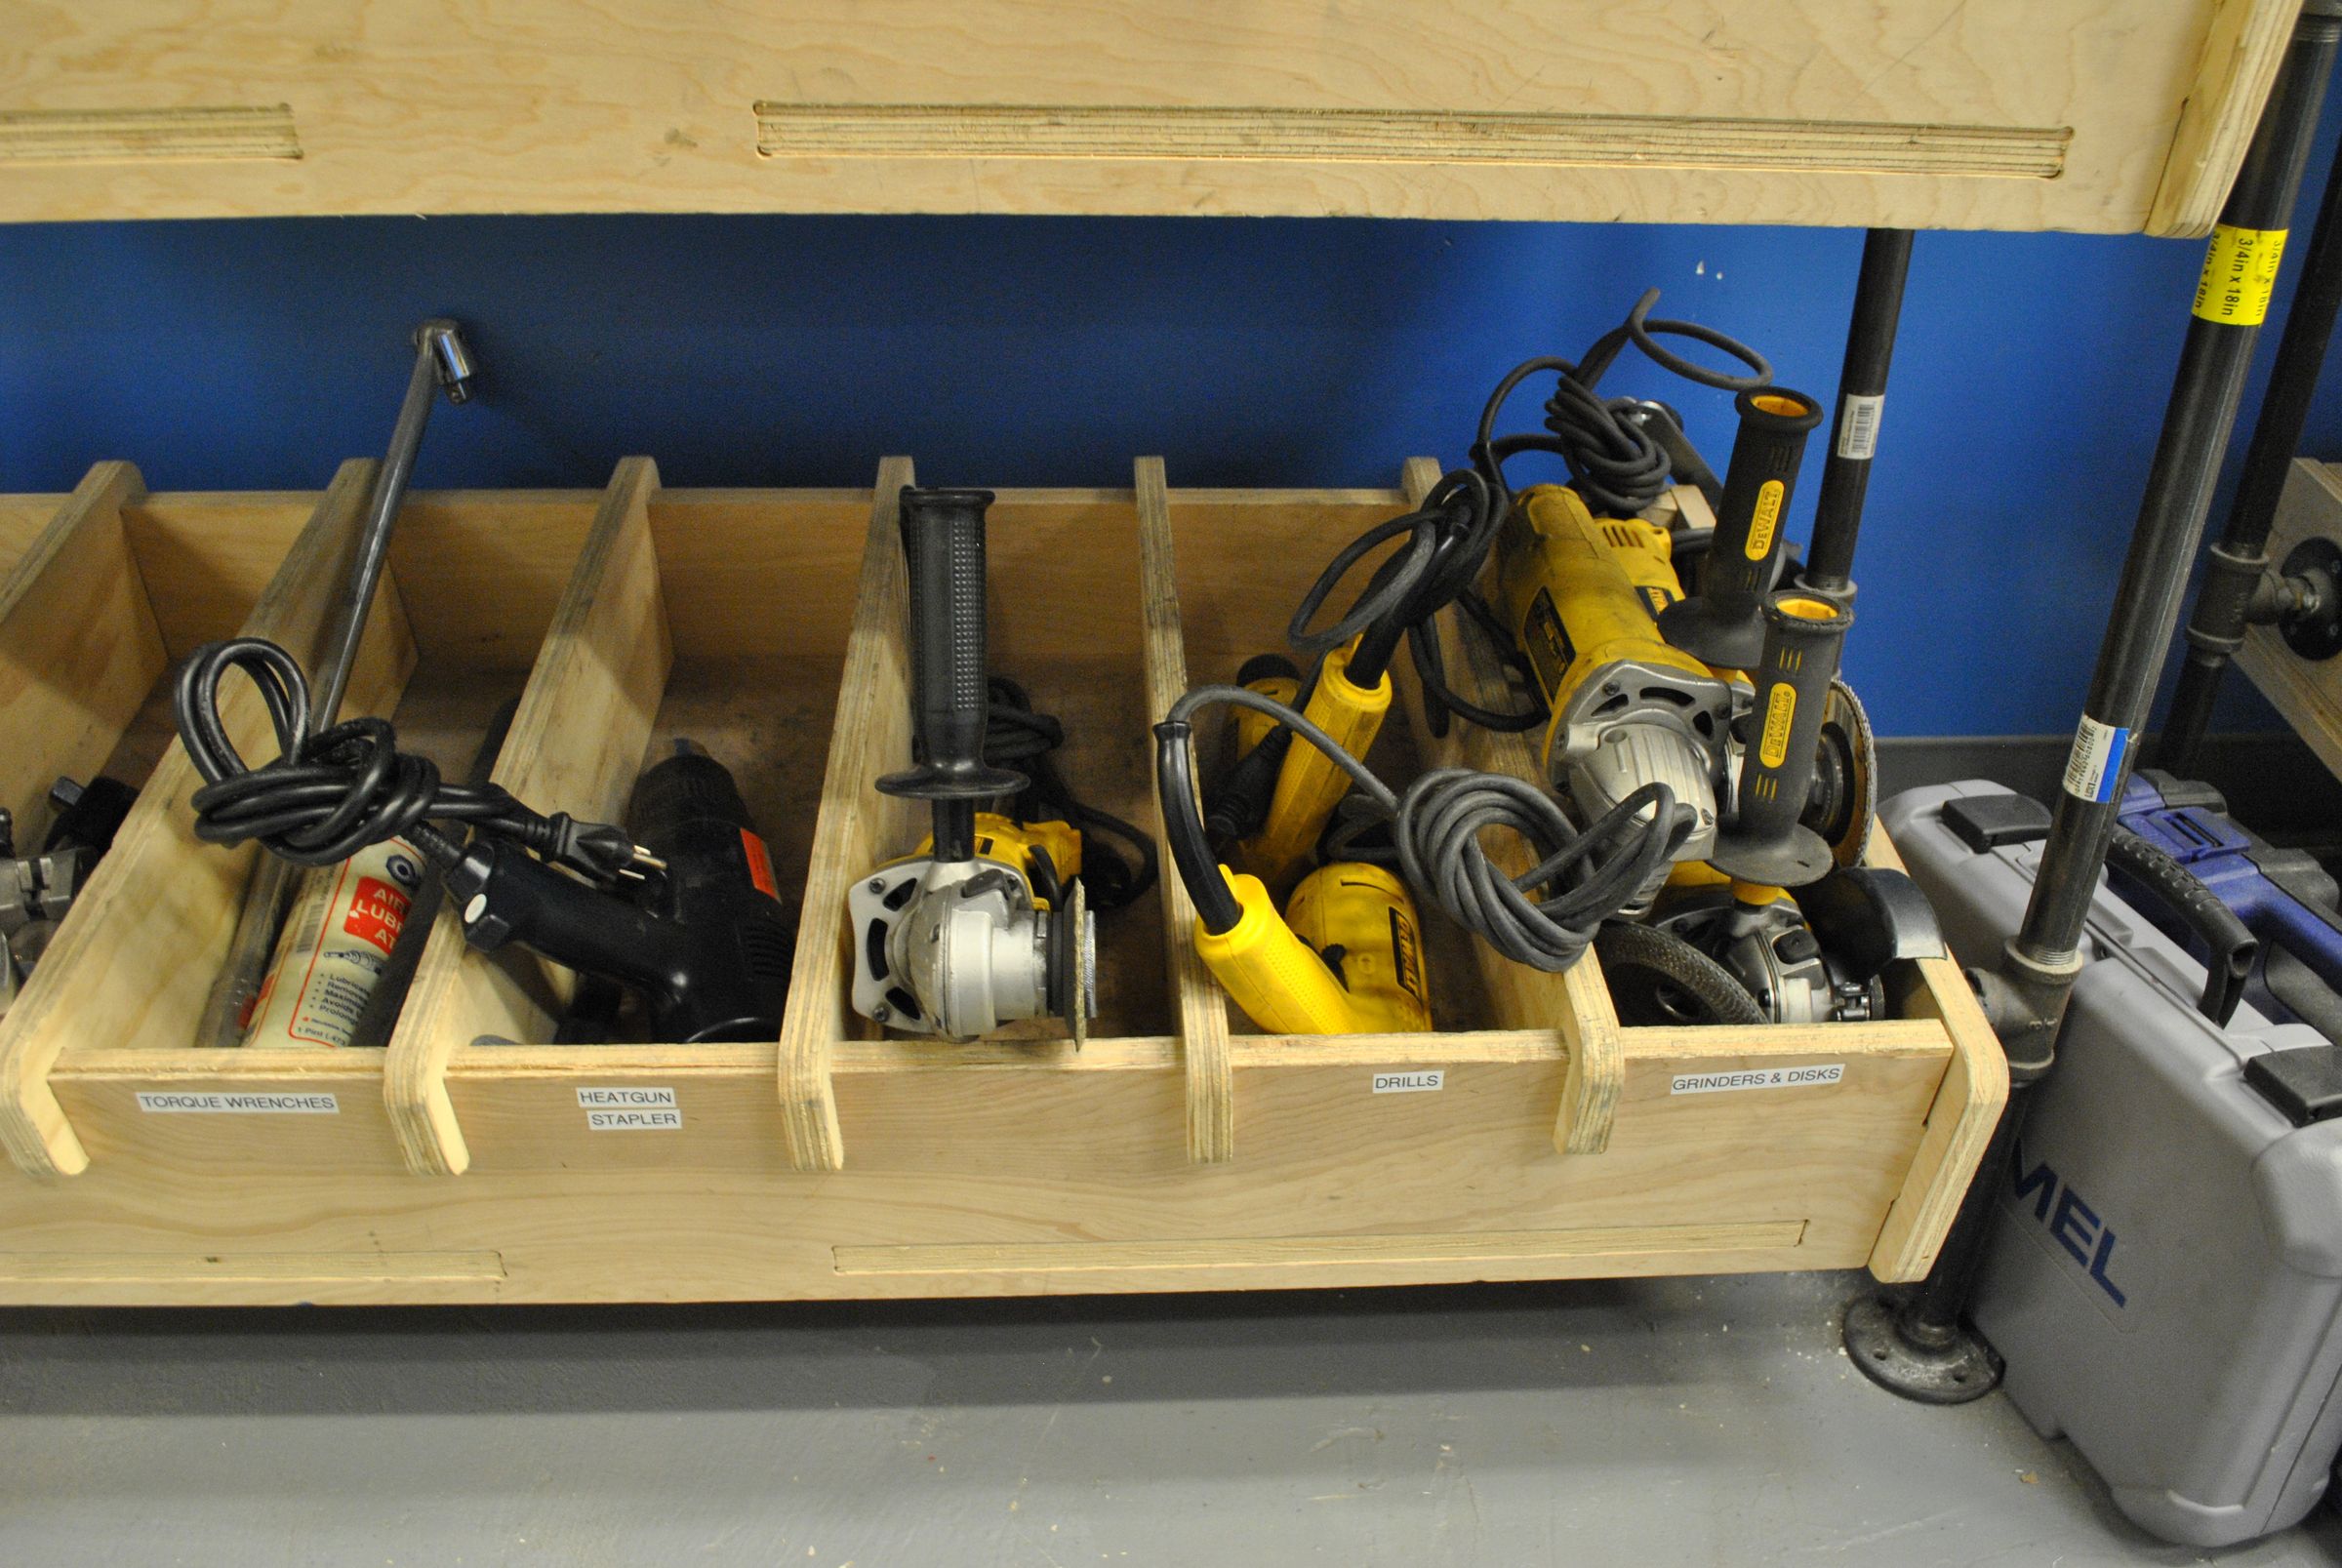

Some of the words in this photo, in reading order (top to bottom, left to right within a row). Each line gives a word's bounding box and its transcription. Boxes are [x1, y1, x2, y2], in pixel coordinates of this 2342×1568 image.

[2233, 237, 2254, 272] 3/4in
[2221, 289, 2241, 316] 18in
[1375, 1075, 1438, 1089] DRILLS
[1673, 1073, 1765, 1091] GRINDERS
[1770, 1072, 1782, 1084] &
[1788, 1067, 1840, 1082] DISKS
[141, 1096, 222, 1108] TORQUE
[225, 1097, 336, 1109] WRENCHES
[580, 1091, 671, 1104] HEATGUN
[591, 1113, 677, 1126] STAPLER
